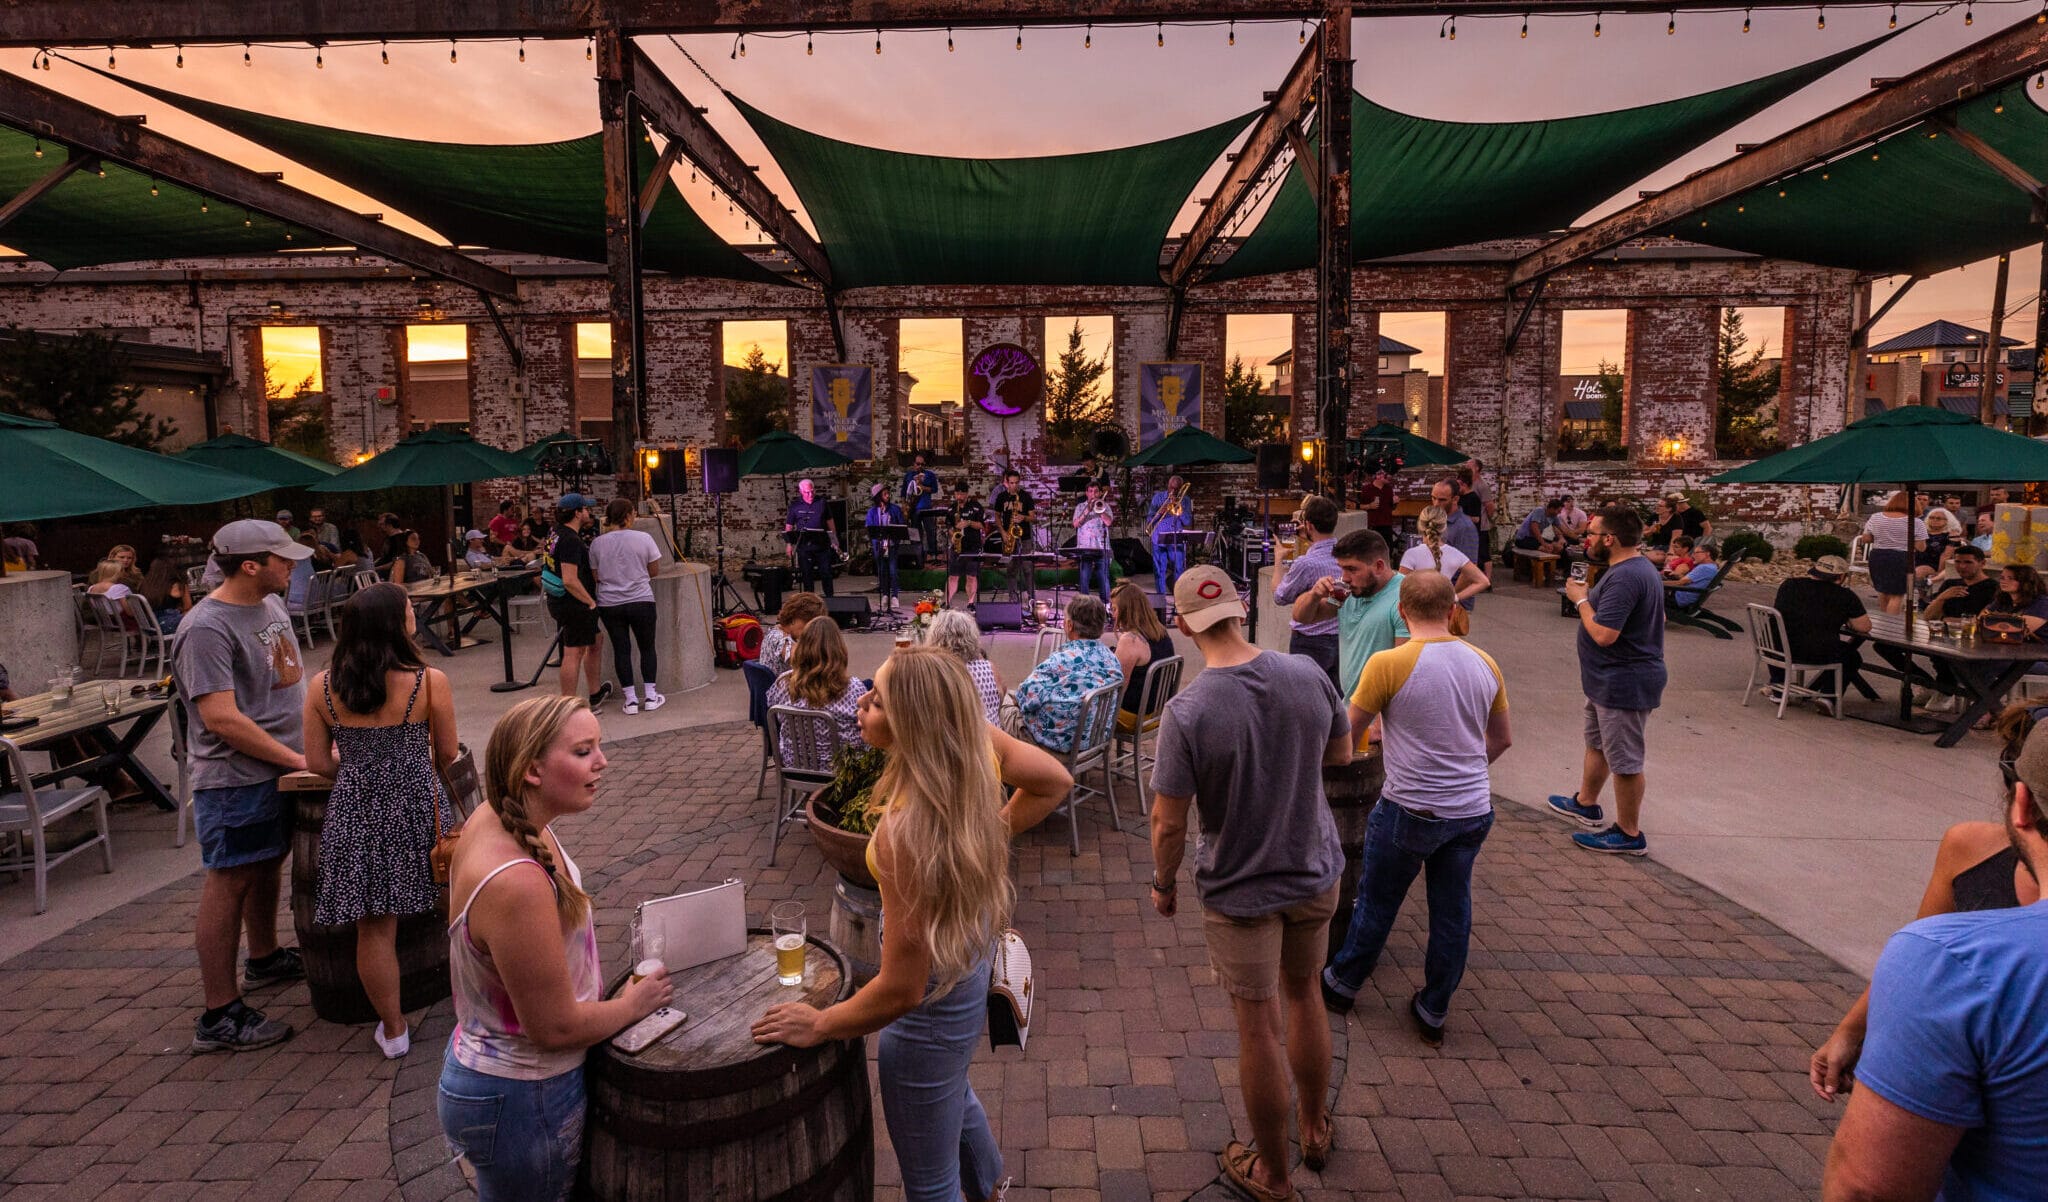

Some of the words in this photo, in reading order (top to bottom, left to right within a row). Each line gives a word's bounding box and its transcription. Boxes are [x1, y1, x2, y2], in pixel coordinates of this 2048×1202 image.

[833, 417, 858, 425] WEEK
[1162, 415, 1188, 424] WEEK
[1197, 580, 1223, 599] C
